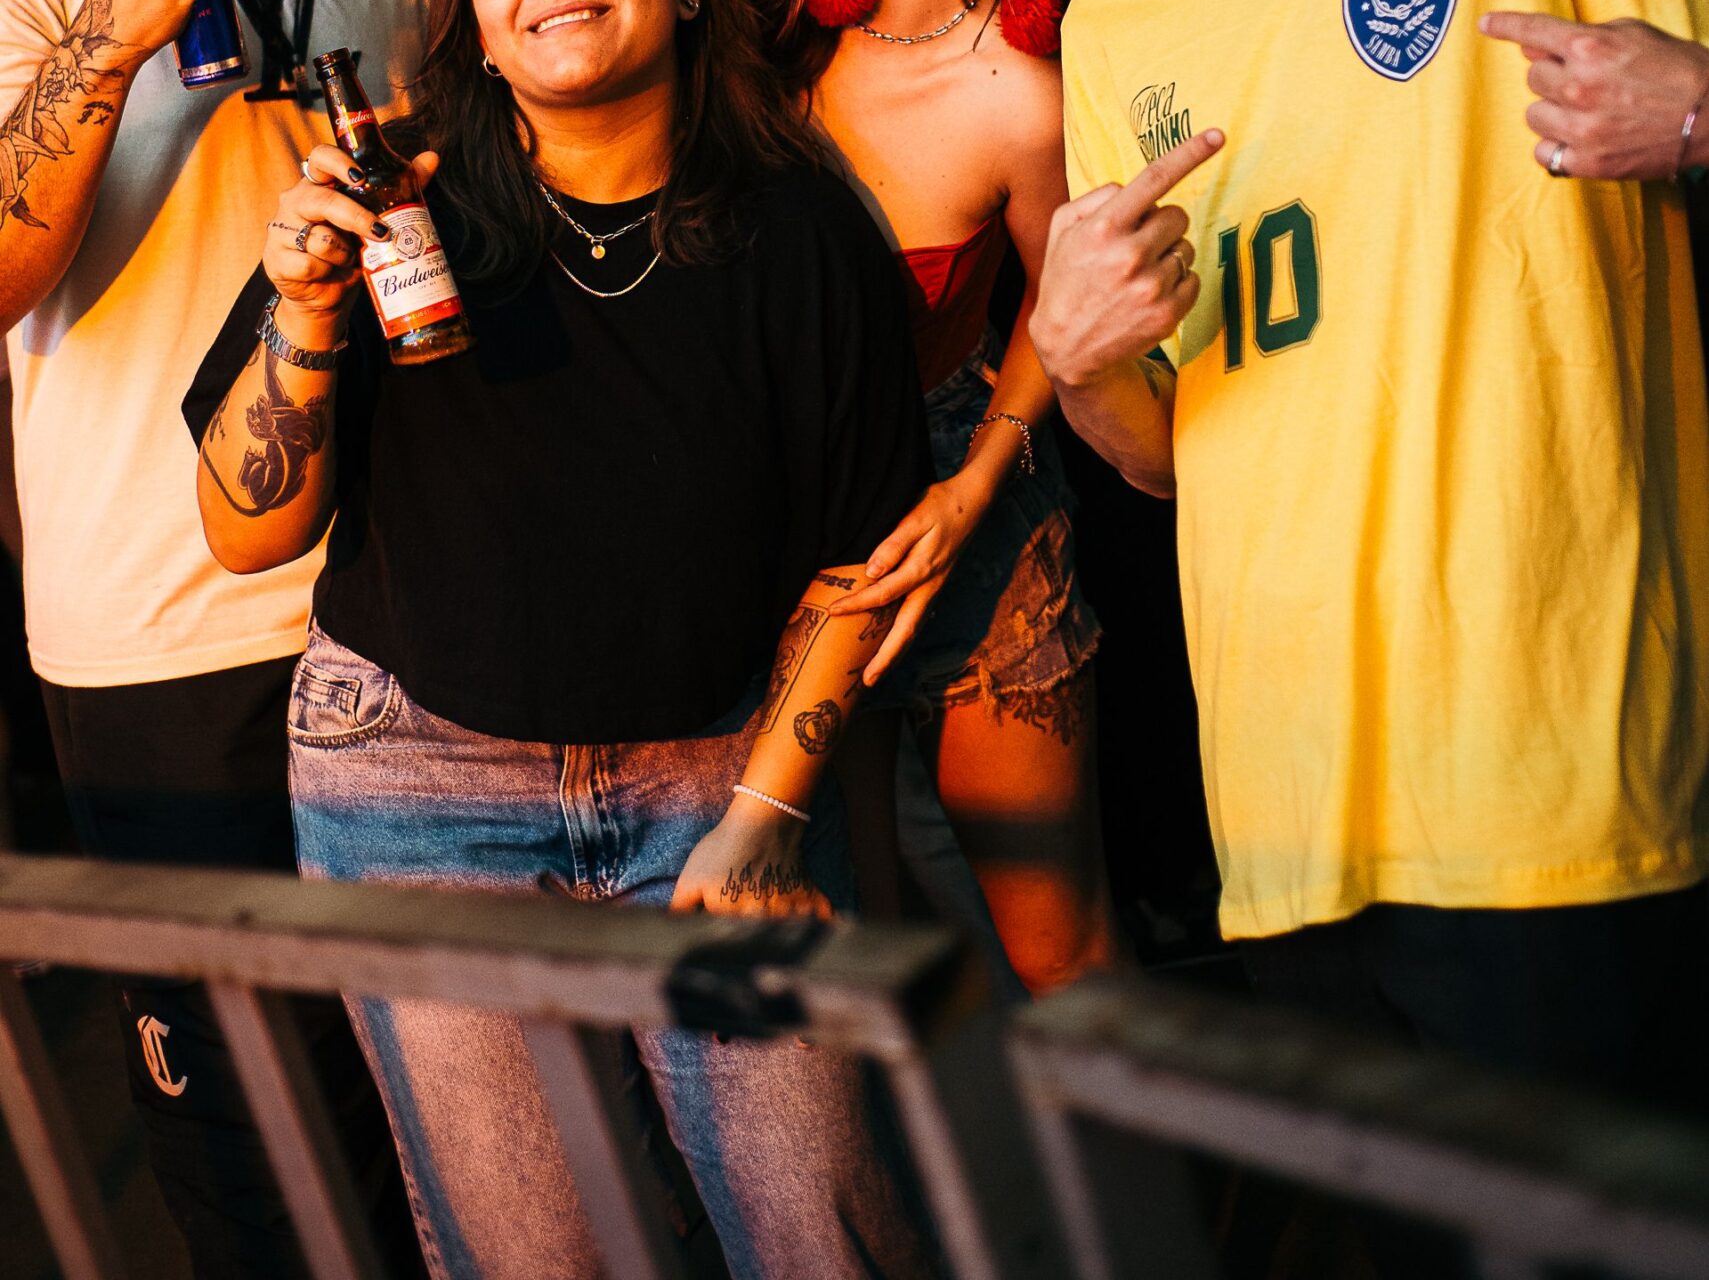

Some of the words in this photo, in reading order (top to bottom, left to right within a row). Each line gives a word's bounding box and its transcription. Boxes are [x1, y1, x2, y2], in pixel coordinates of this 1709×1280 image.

[1364, 33, 1401, 68] SAMBA
[1405, 22, 1440, 61] CLUBE
[377, 261, 451, 297] Budweise
[1217, 197, 1324, 374] 10
